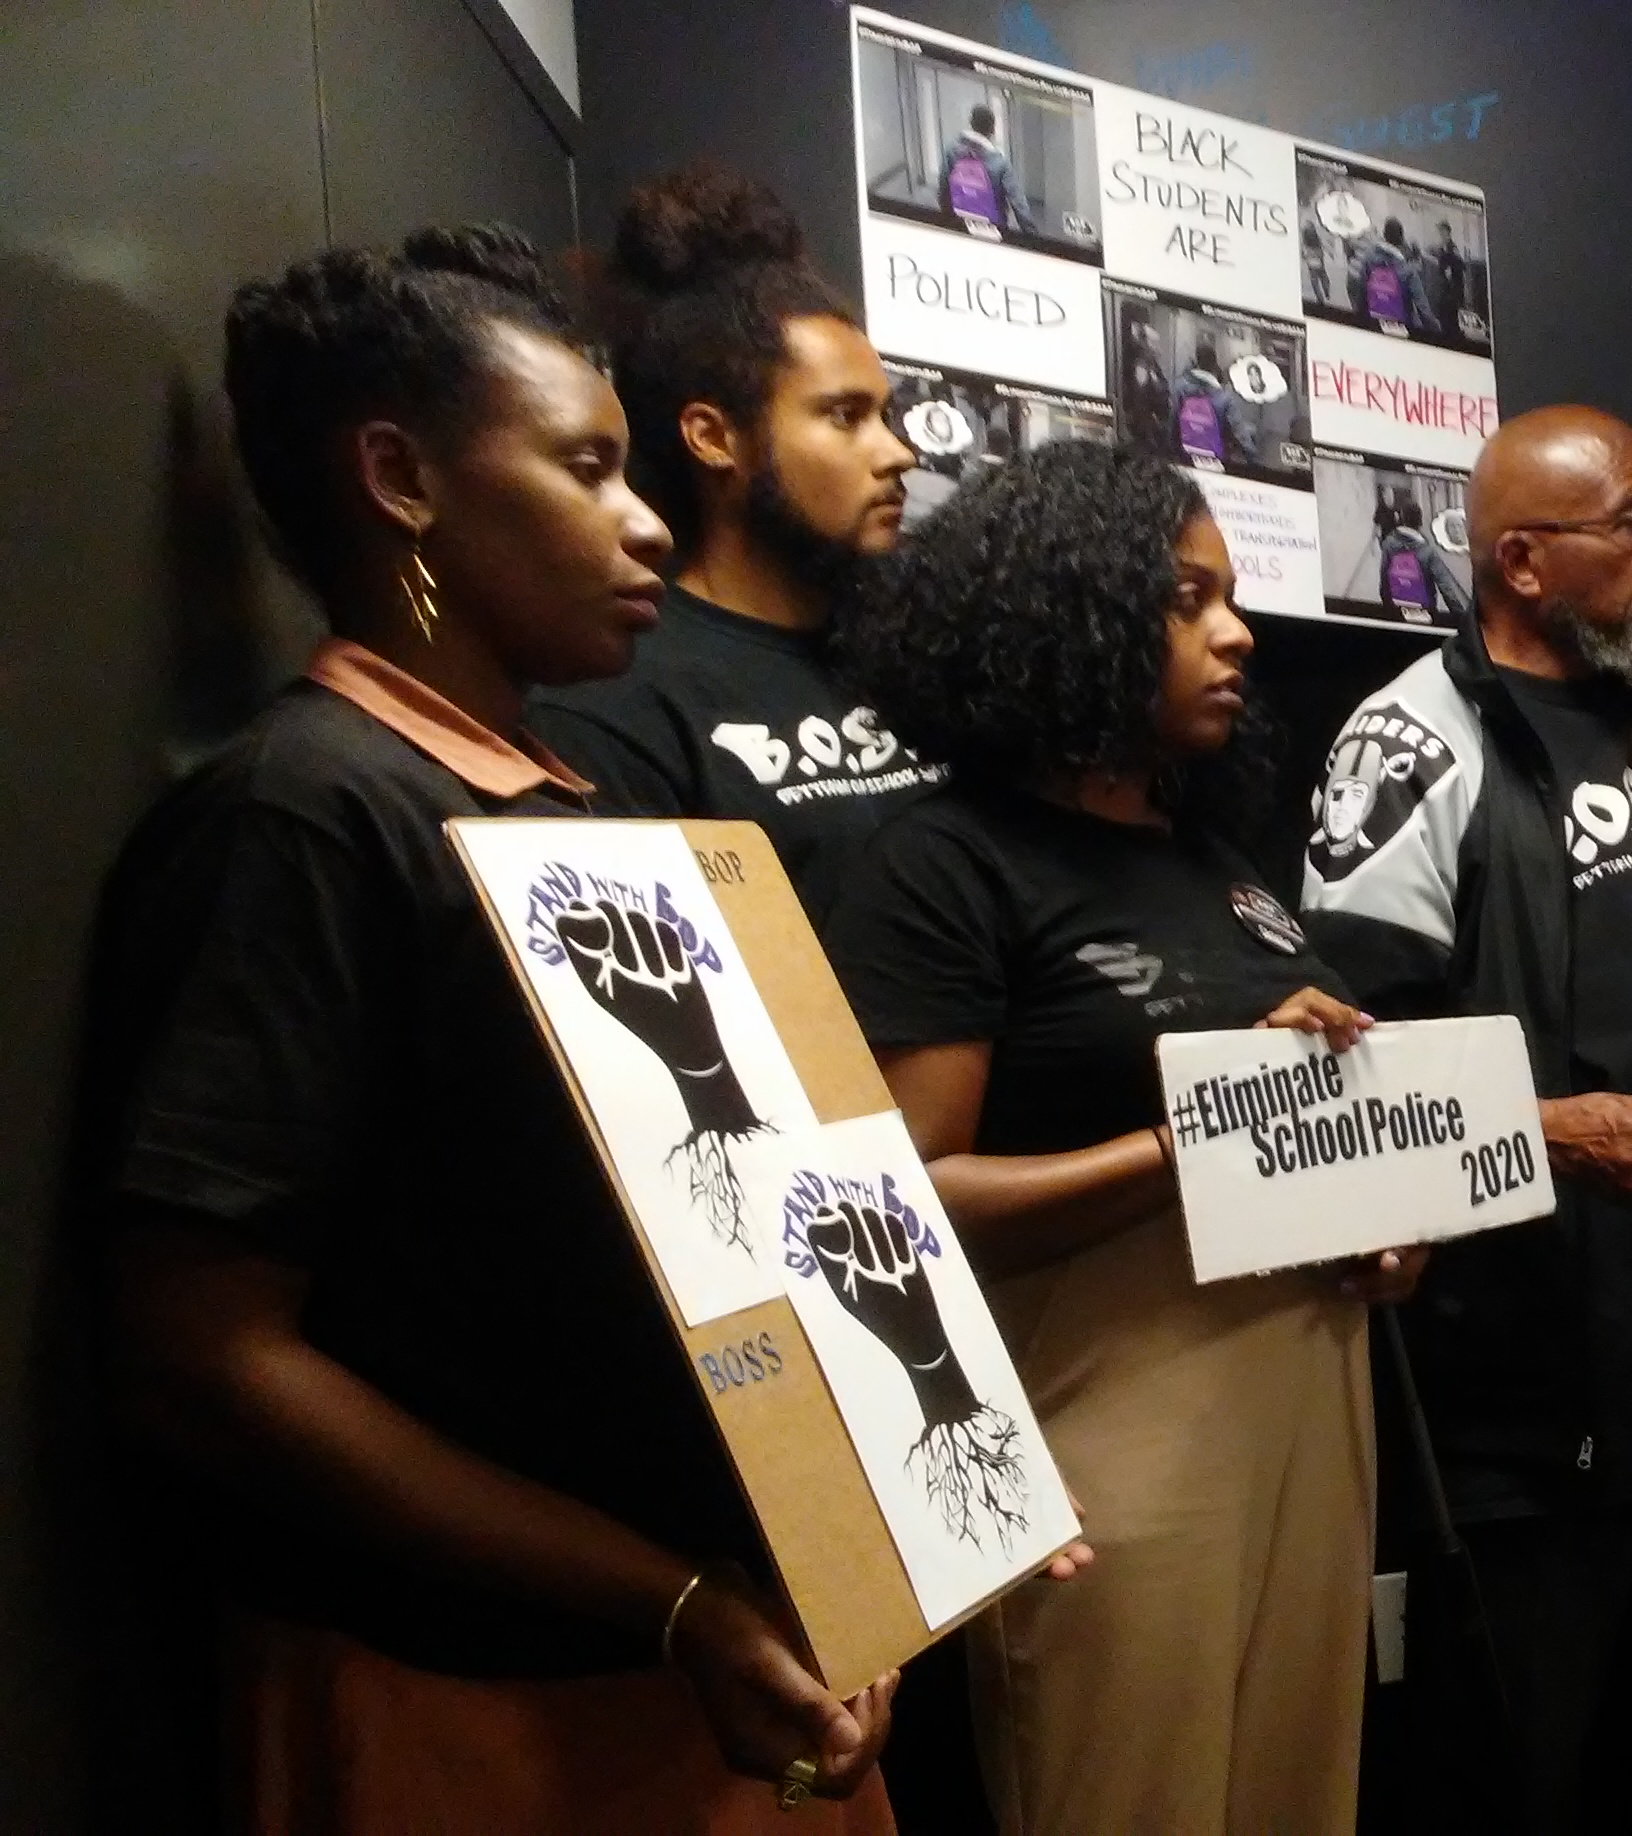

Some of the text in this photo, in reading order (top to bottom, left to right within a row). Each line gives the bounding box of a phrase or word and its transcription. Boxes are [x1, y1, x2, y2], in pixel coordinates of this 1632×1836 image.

[1136, 112, 1254, 179] BLACK
[1106, 160, 1289, 237] STUDENTS
[1165, 223, 1237, 268] ARE
[889, 252, 1067, 328] POLICED
[1312, 359, 1499, 438] EVERYWHERE
[1232, 552, 1283, 580] OOLS
[694, 849, 746, 884] BOP
[525, 860, 724, 975] STAND WITH BOP
[1172, 1051, 1345, 1149] #Eliminate
[1460, 1129, 1536, 1209] 2020
[782, 1168, 942, 1280] STAND WITH BOP
[700, 1330, 783, 1396] BOSS
